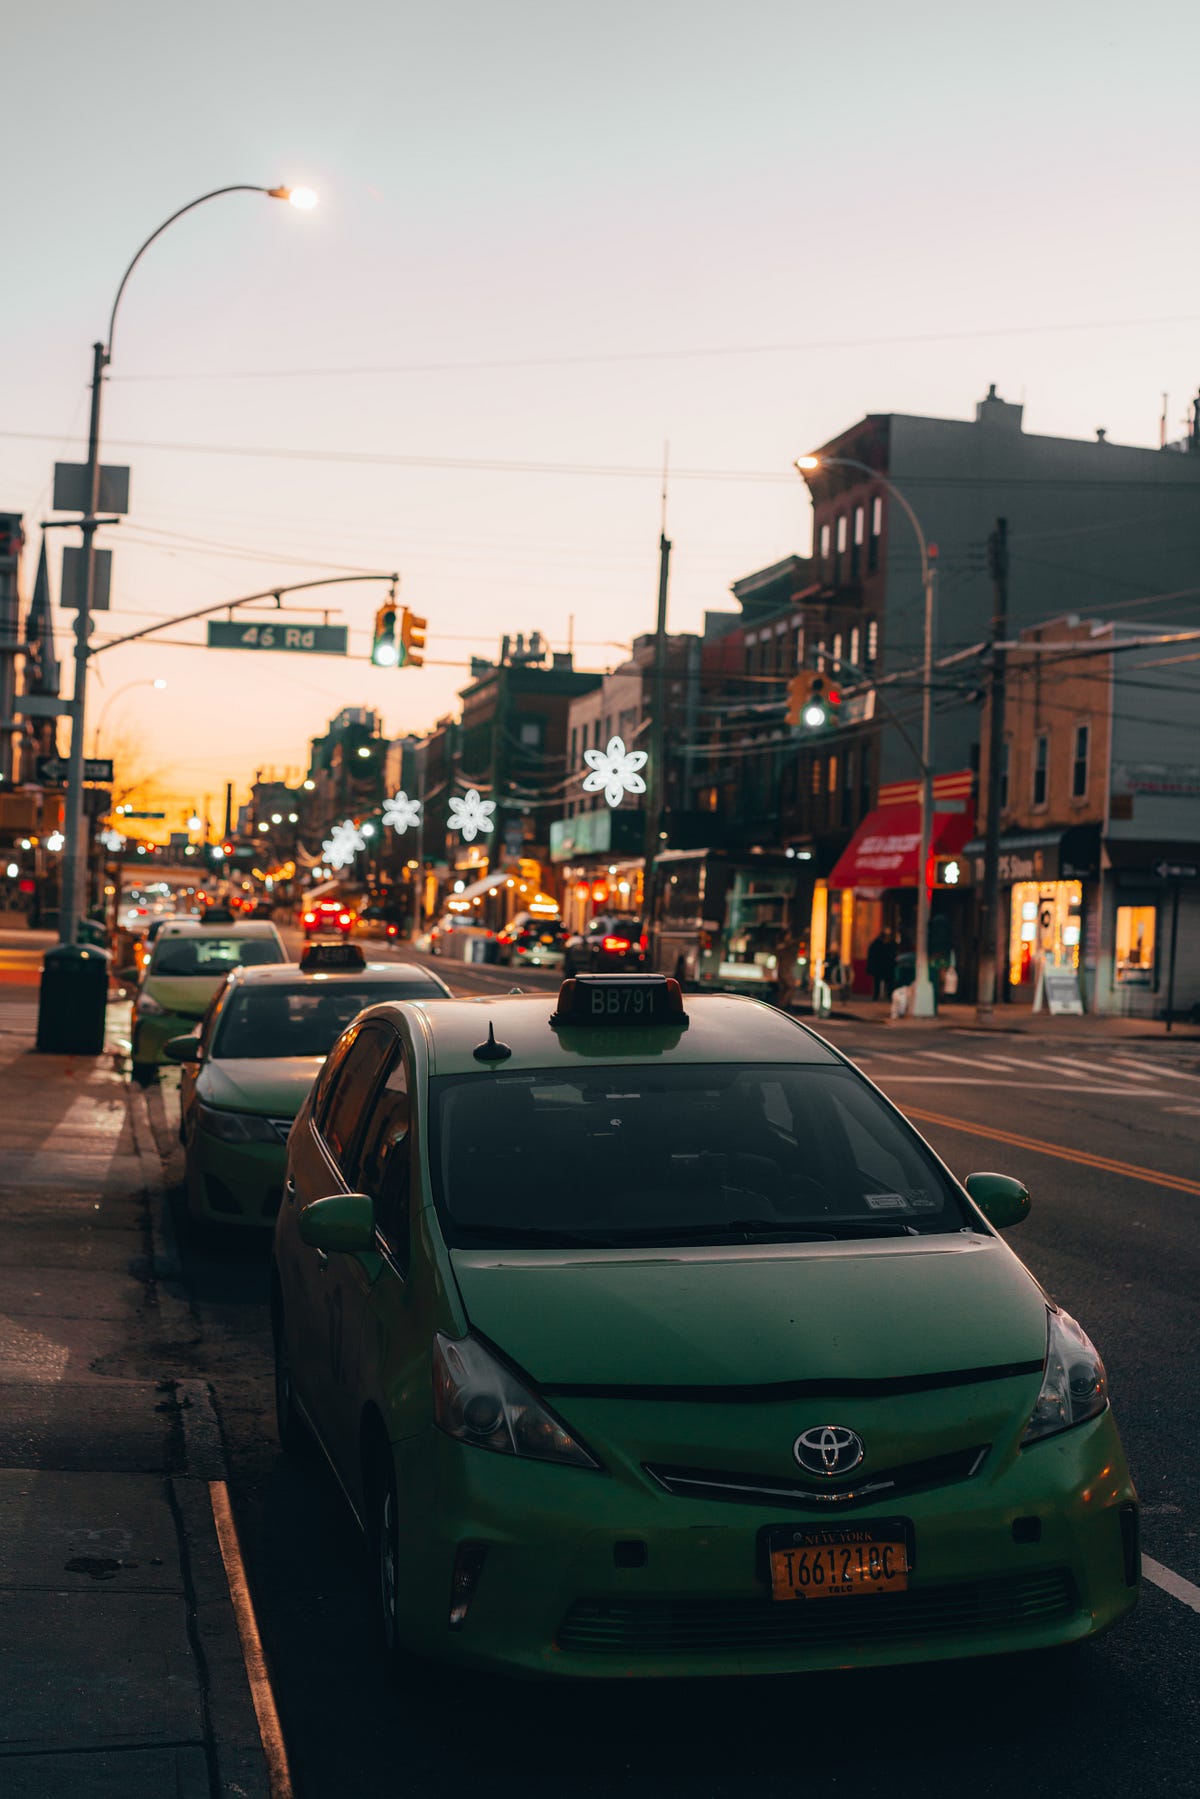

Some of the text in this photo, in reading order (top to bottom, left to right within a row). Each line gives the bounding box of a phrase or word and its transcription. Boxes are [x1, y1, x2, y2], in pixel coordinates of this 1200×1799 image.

[242, 626, 315, 648] 46 Rd
[591, 988, 655, 1014] BB791
[804, 1531, 873, 1546] NEW YORK
